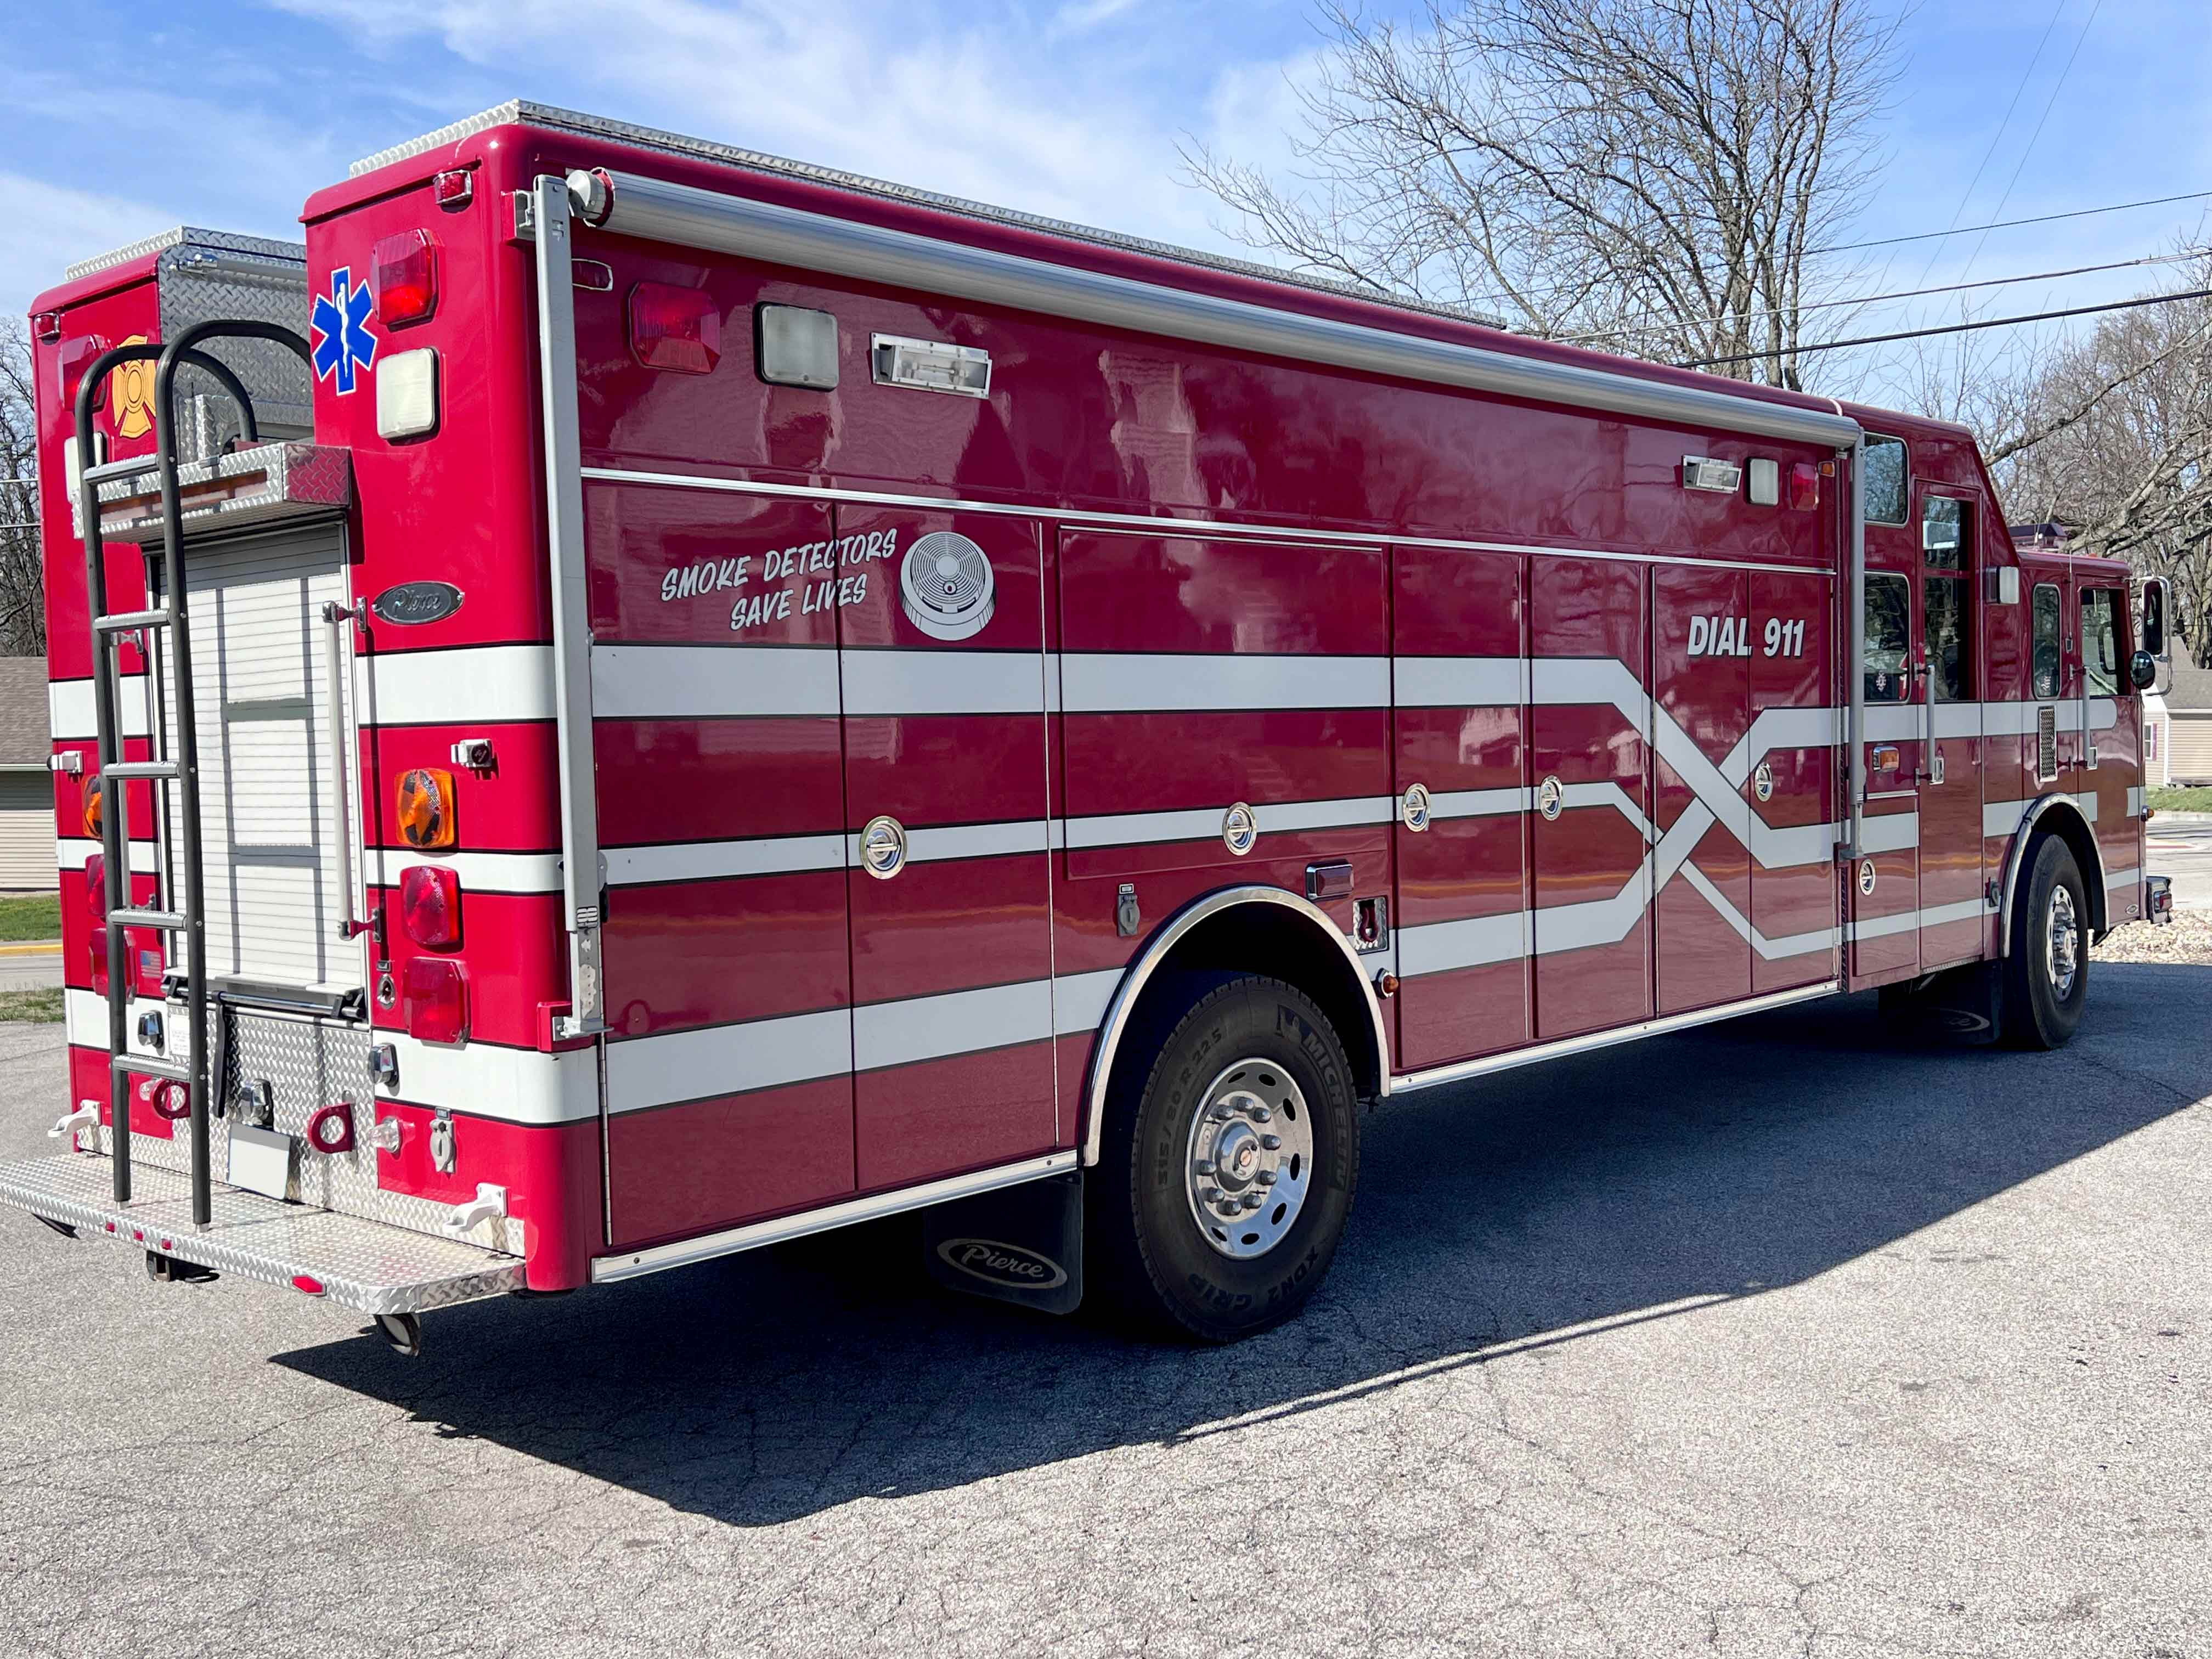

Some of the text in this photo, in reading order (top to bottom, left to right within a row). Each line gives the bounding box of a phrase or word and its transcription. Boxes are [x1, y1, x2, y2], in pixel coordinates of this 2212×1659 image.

[661, 528, 898, 602] SMOKE DETECTORS
[393, 588, 441, 618] Pierce
[729, 573, 868, 631] SAVE LIVES
[1687, 615, 1805, 658] DIAL 911
[1304, 1032, 1347, 1189] MICHELIN
[961, 1244, 1044, 1278] Pierce
